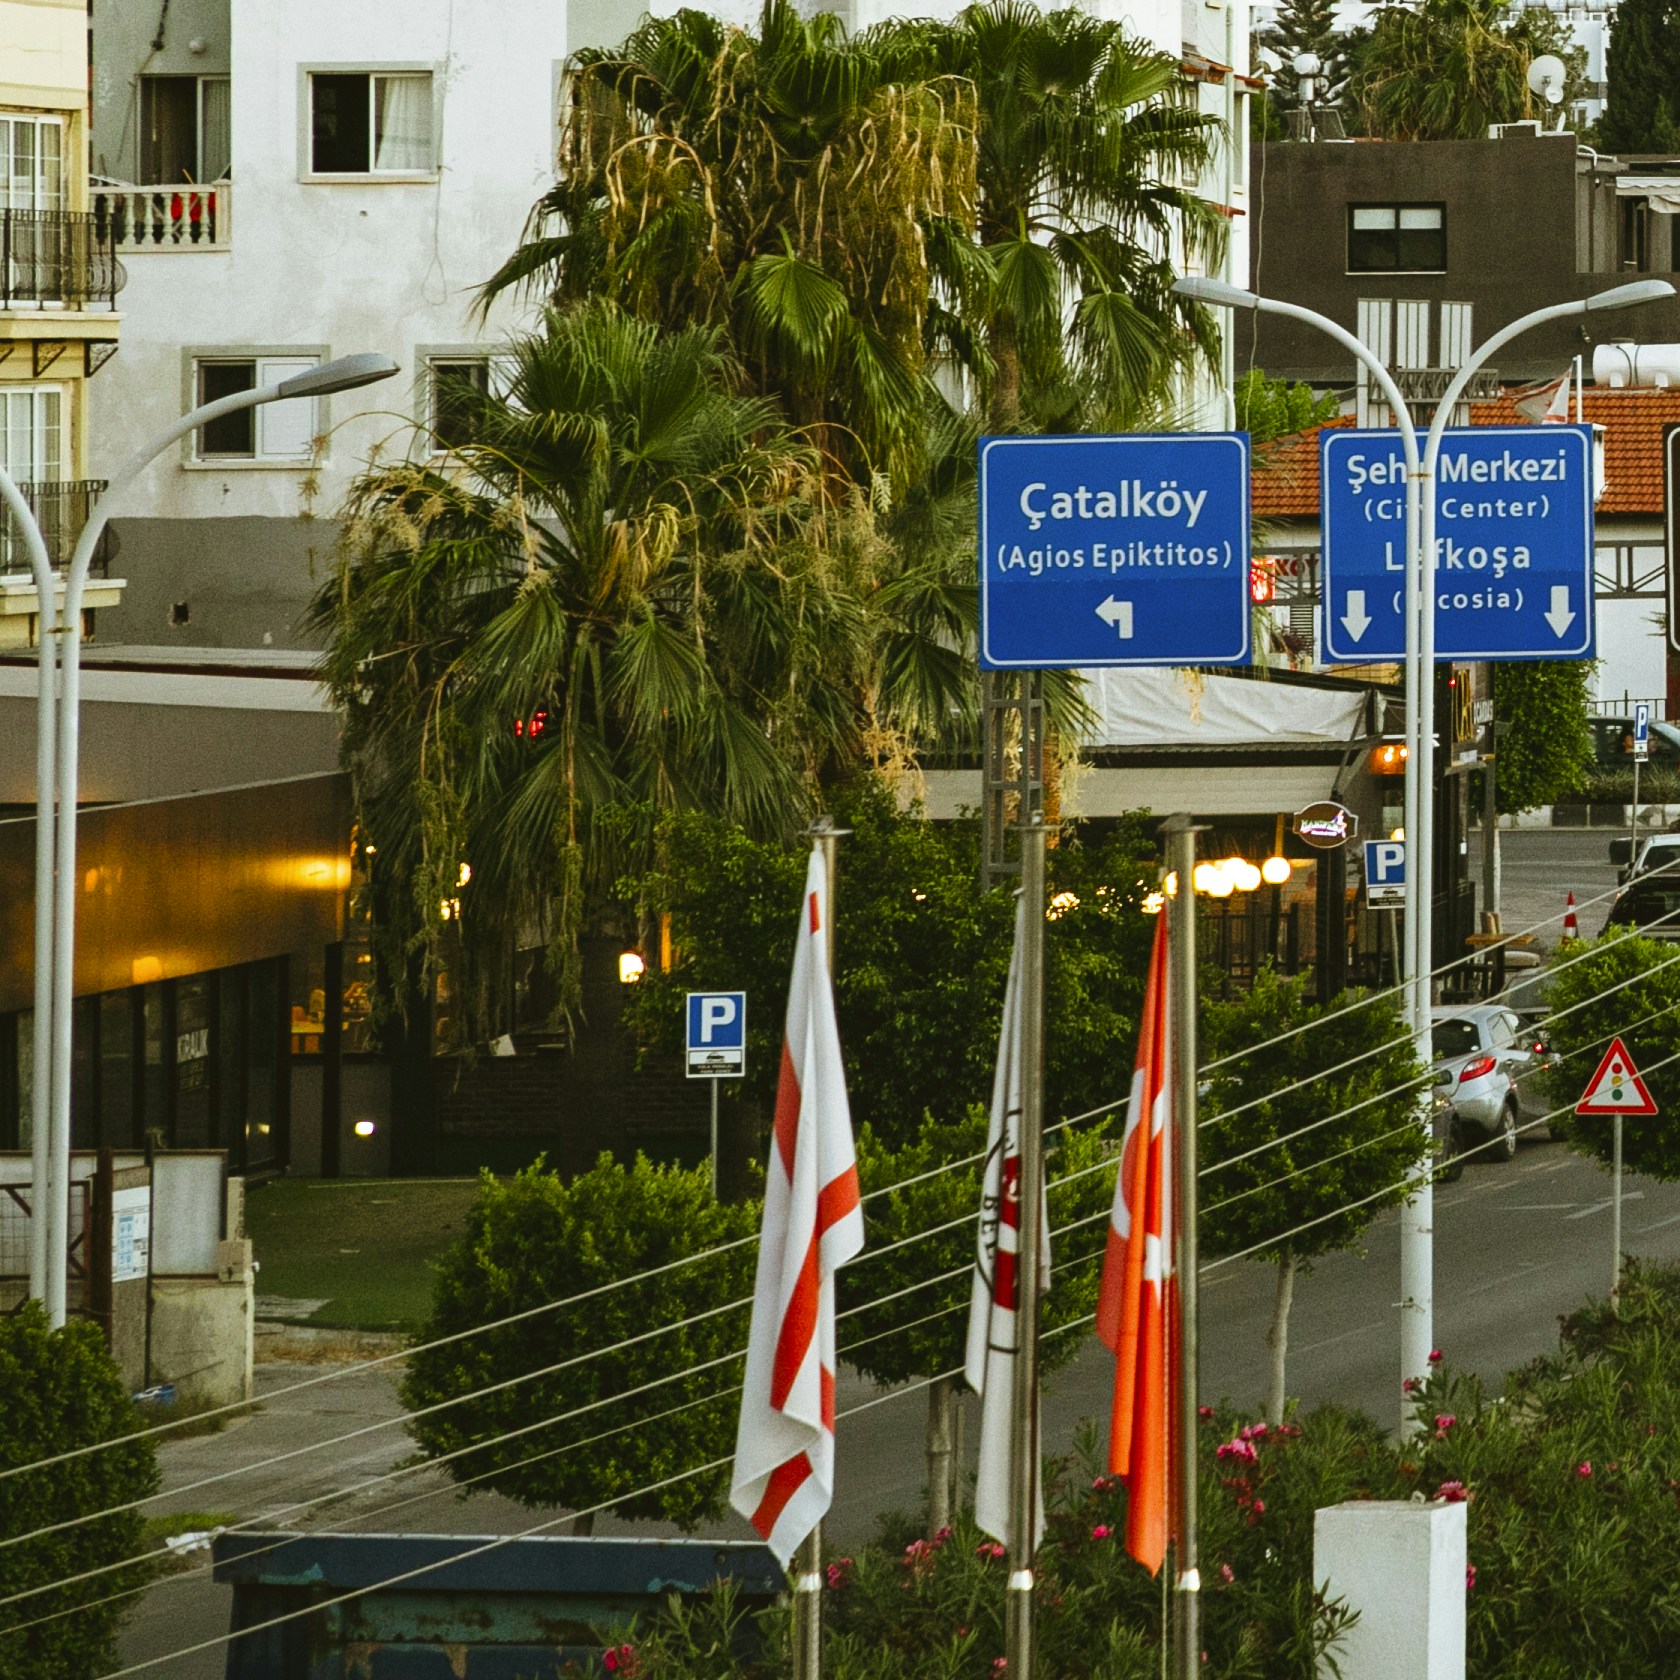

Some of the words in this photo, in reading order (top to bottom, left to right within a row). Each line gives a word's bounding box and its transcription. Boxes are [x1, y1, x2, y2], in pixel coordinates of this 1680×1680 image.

[1347, 453, 1425, 494] Şeh
[1441, 449, 1566, 482] Merkezi
[1020, 479, 1207, 531] Çatalköy
[1365, 497, 1422, 521] (Ci
[1441, 494, 1549, 519] Center)
[998, 543, 1084, 576] (Agios
[1092, 540, 1232, 574] Epiktitos)
[1386, 538, 1531, 578] Lfkoşa
[1393, 588, 1523, 613] (cosia)
[1637, 706, 1648, 738] P
[1376, 843, 1405, 881] P
[701, 997, 736, 1043] P
